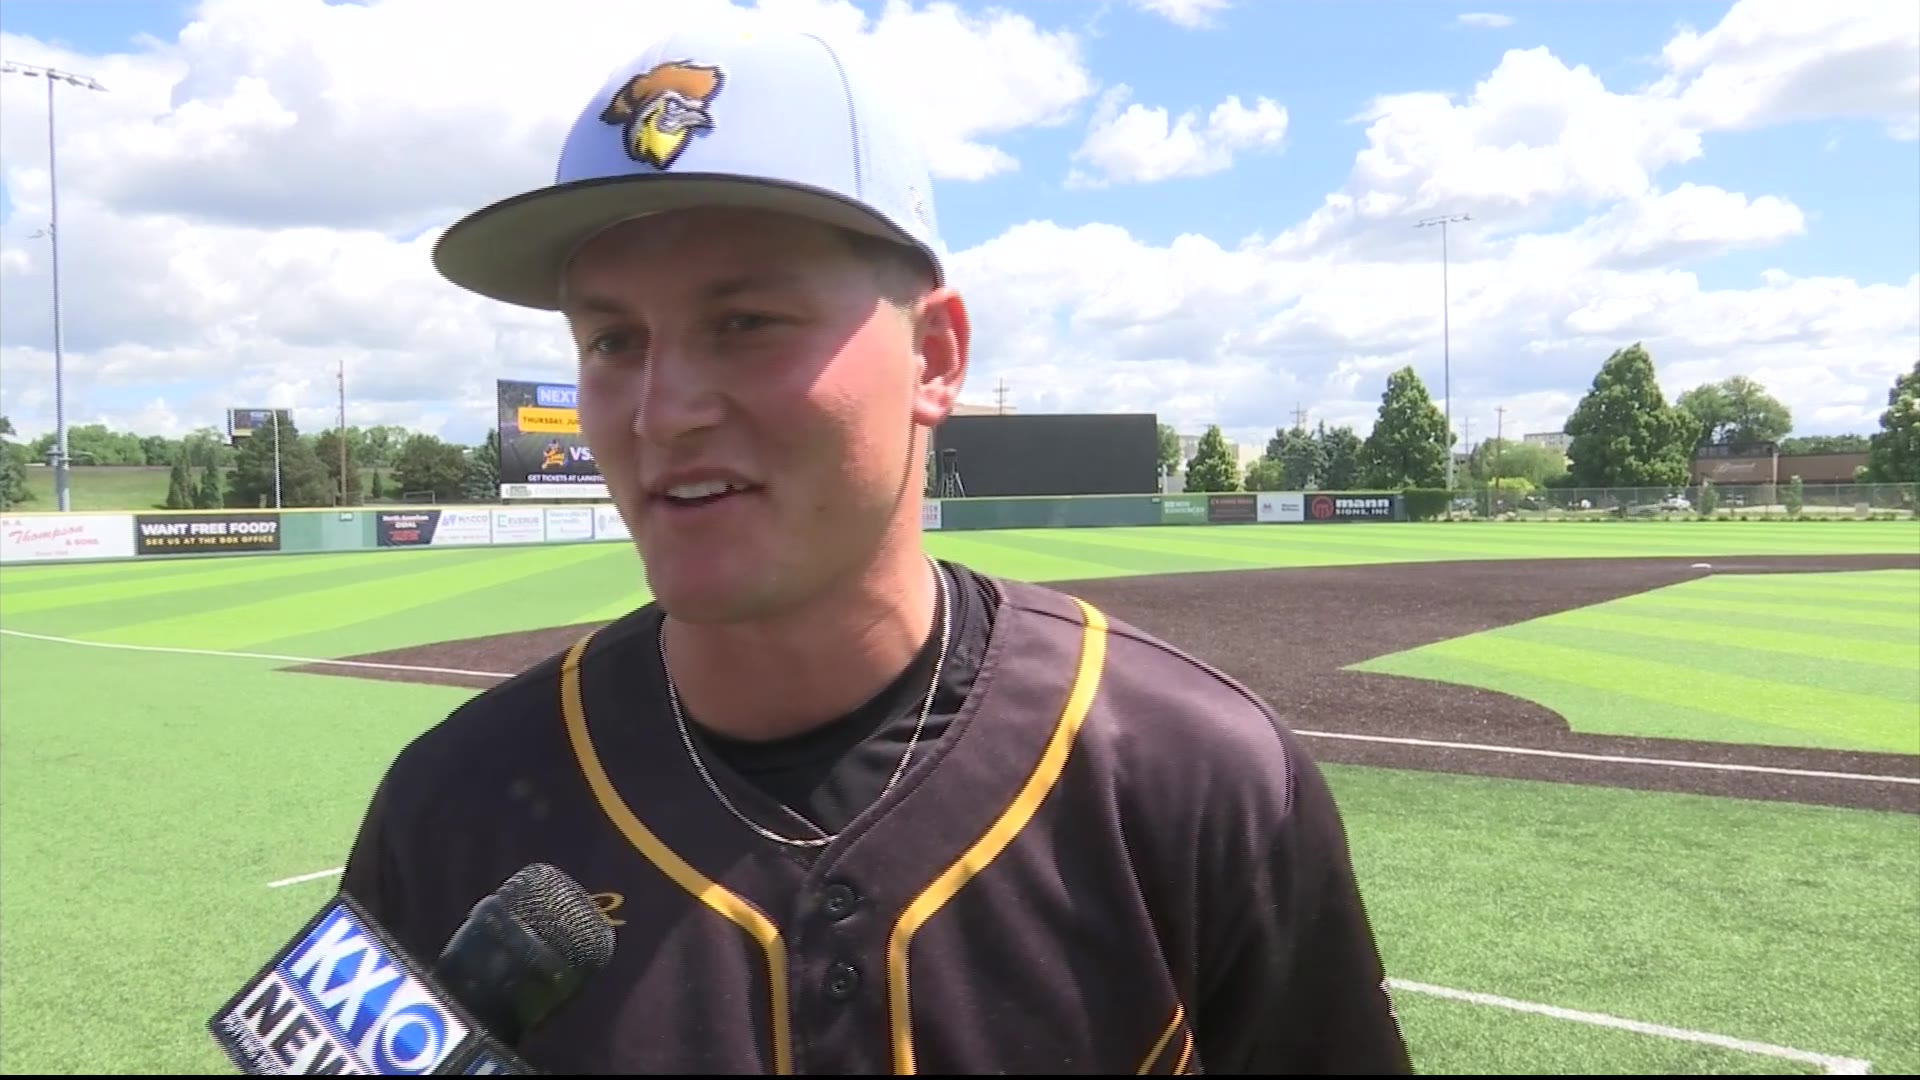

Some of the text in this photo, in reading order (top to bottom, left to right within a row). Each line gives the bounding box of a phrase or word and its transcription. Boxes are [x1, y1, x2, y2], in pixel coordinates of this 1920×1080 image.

[1335, 498, 1390, 508] mann
[9, 526, 84, 544] Thompson
[140, 521, 277, 536] WANT FREE FOOD?
[145, 535, 274, 546] SEE US AT THE BOX OFFICE
